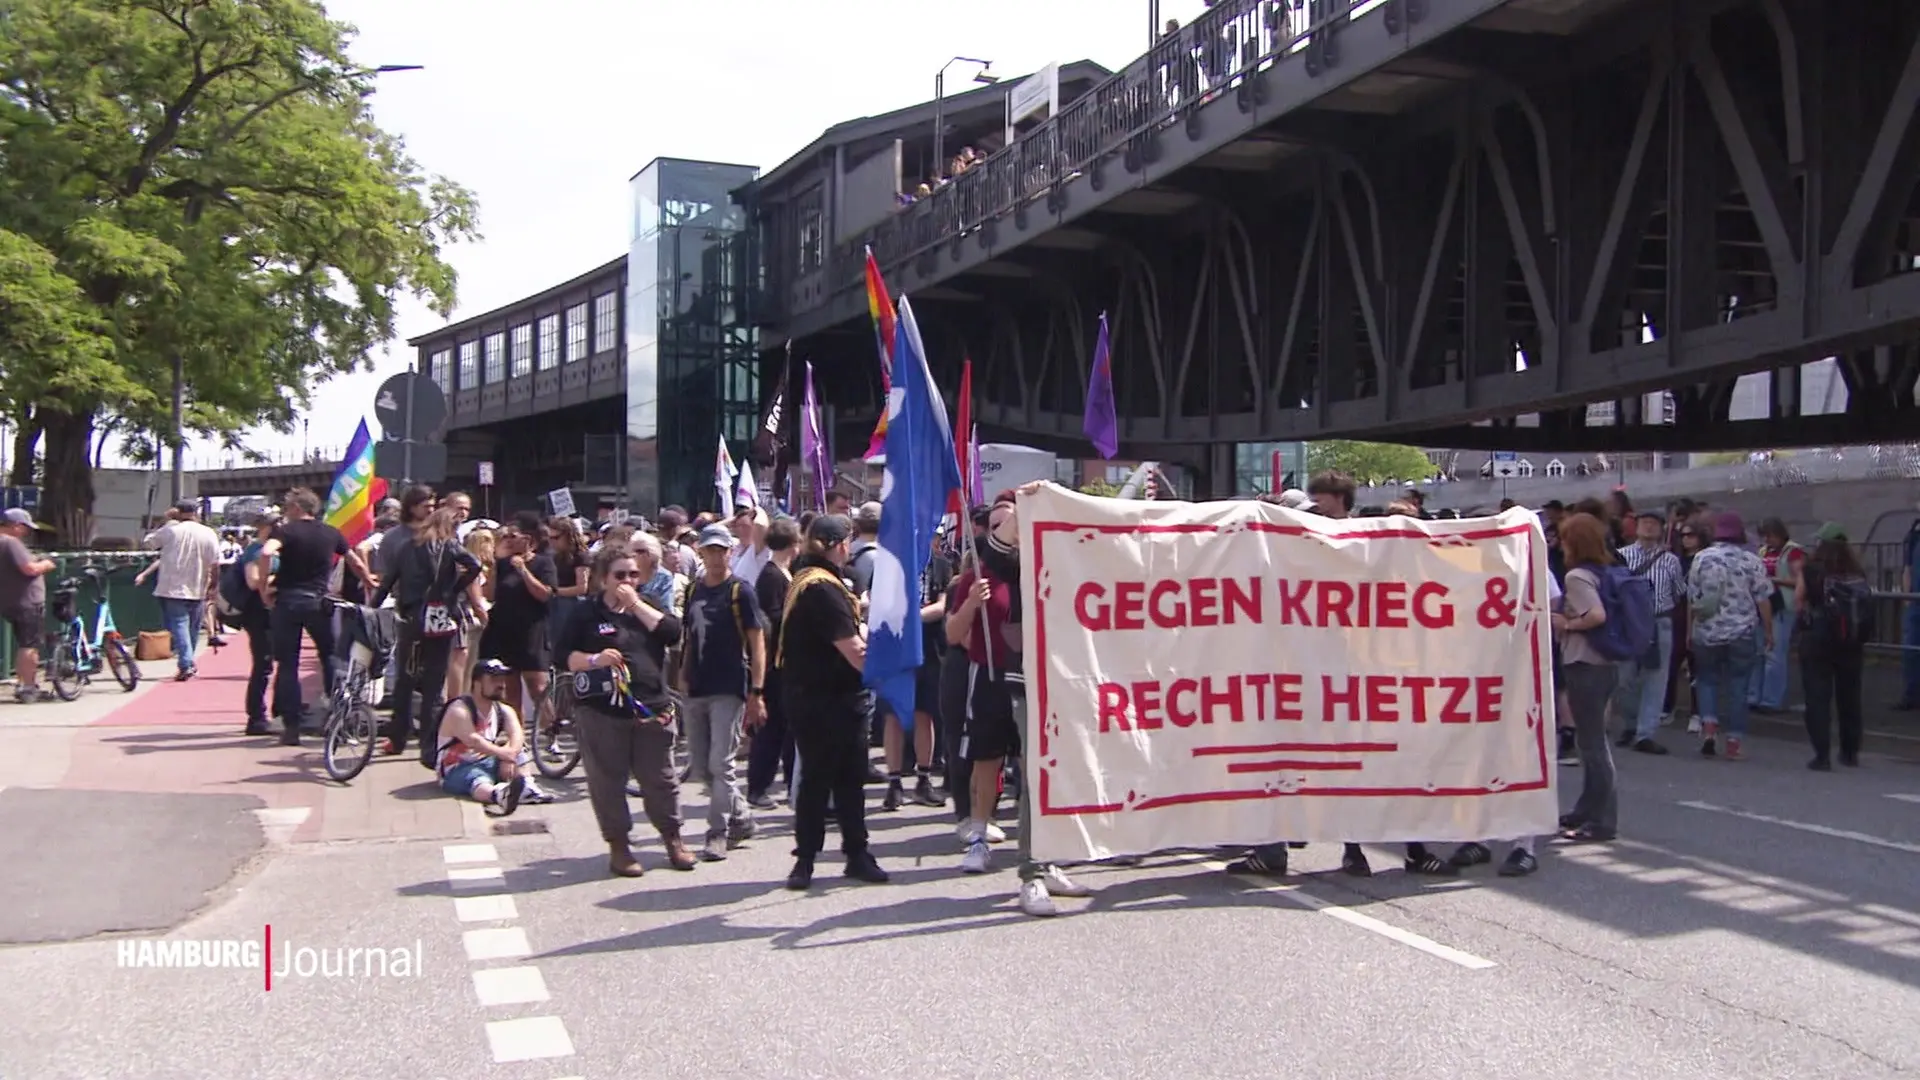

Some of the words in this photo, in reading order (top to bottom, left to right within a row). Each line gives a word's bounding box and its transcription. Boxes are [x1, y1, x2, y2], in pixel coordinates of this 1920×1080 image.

[1074, 576, 1262, 631] GEGEN
[1277, 578, 1454, 629] KRIEG
[1476, 577, 1517, 629] &
[1098, 673, 1303, 733] RECHTE
[1321, 674, 1504, 723] HETZE
